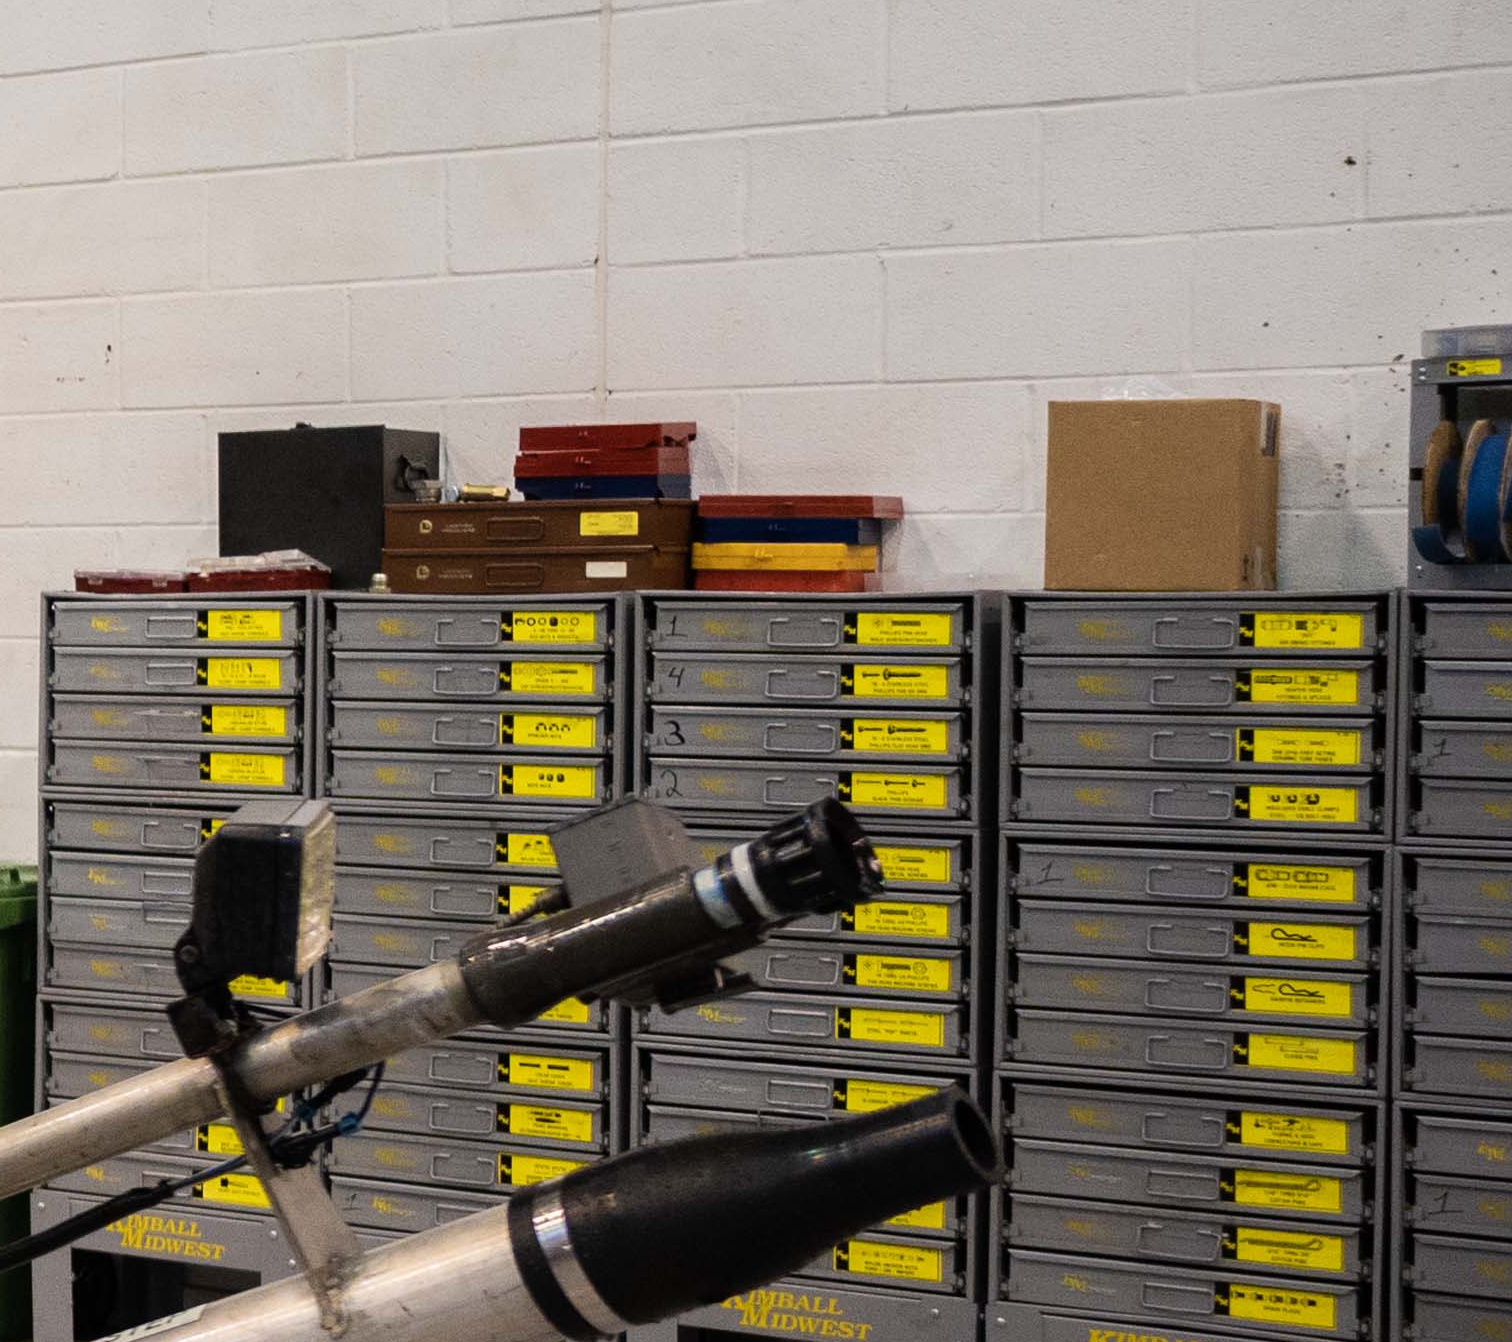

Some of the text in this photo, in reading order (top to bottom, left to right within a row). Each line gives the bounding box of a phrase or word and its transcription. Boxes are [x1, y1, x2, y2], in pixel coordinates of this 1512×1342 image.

[666, 616, 688, 636] 1
[668, 667, 685, 687] 4
[663, 720, 685, 746] 3
[660, 769, 683, 798] 2
[121, 1228, 226, 1259] MIDWEST
[739, 1306, 873, 1341] MIDWEST
